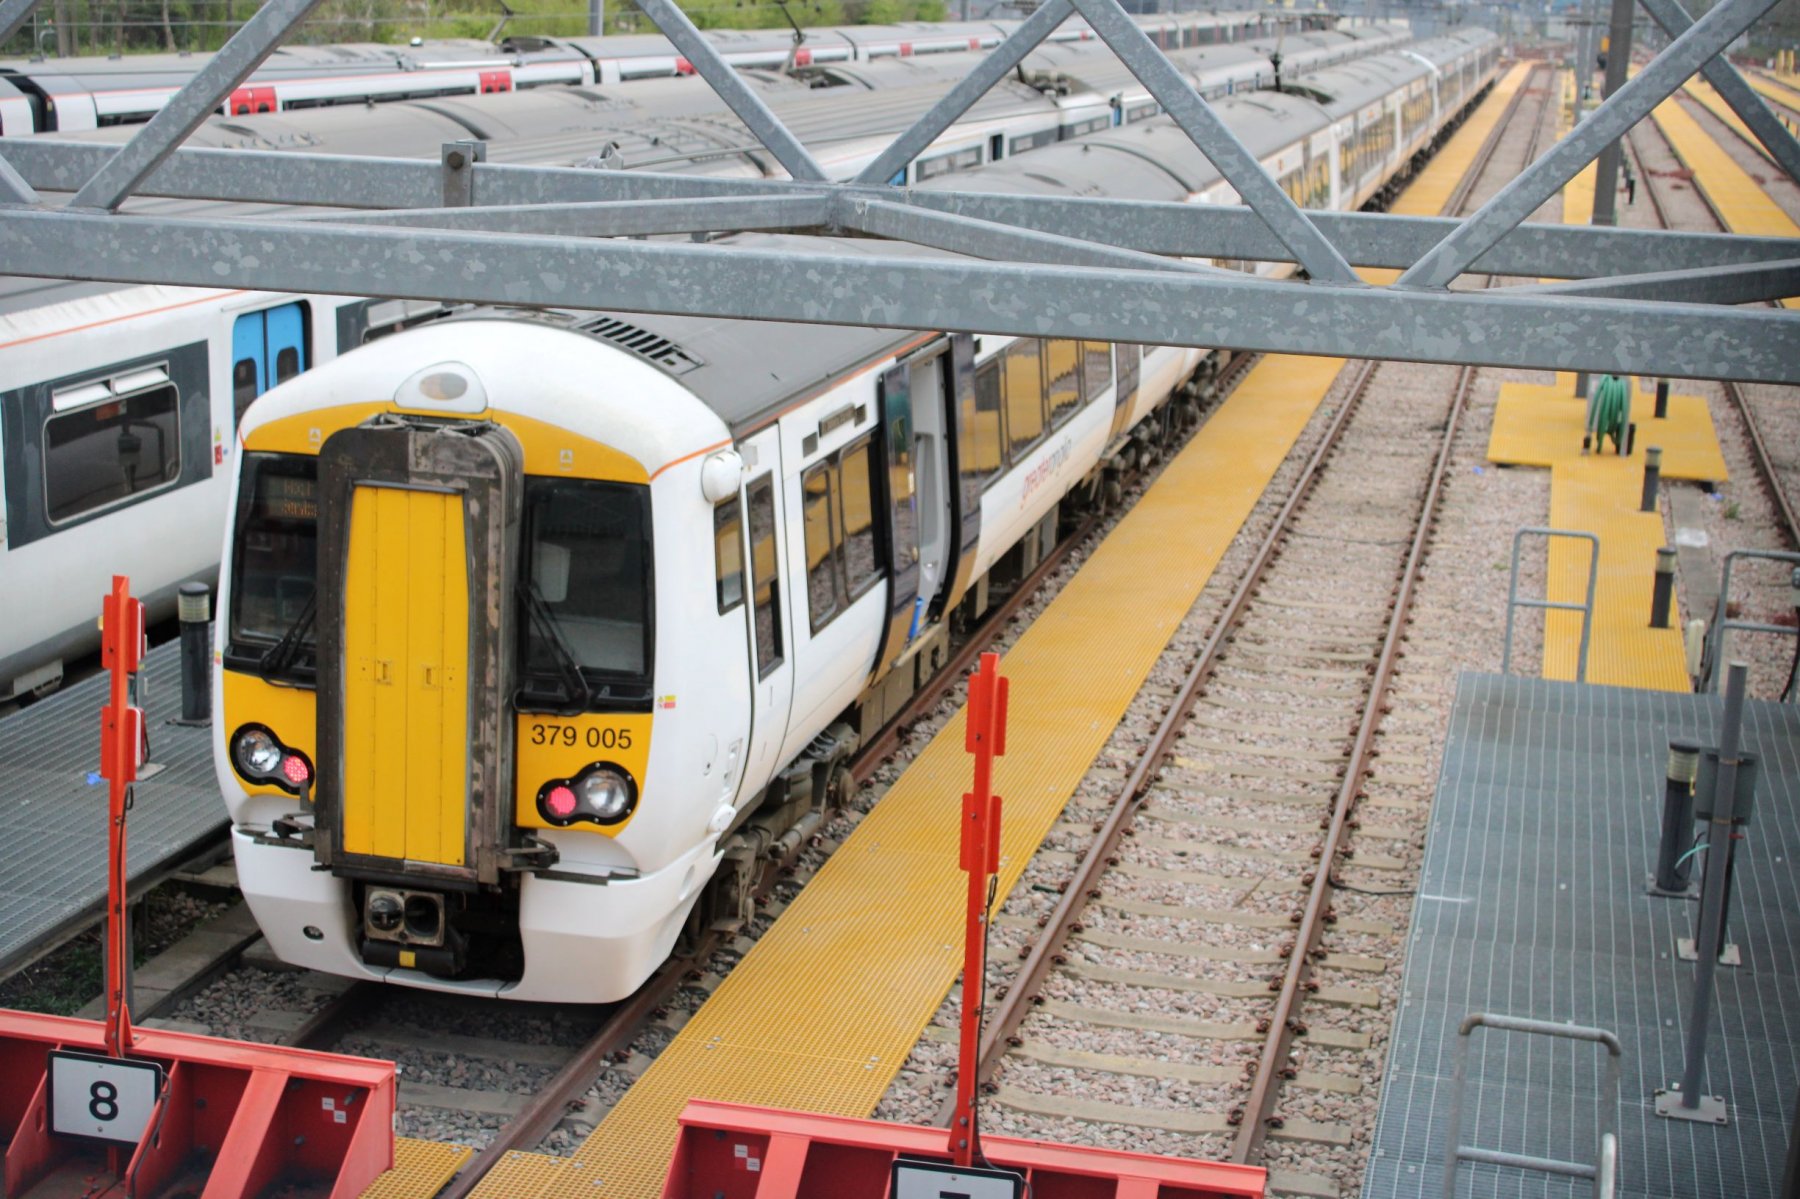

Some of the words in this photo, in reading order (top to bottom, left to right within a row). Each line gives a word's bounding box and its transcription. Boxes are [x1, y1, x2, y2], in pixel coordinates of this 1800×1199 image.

[531, 723, 577, 746] 379
[586, 727, 632, 749] 005
[89, 1080, 119, 1122] 8
